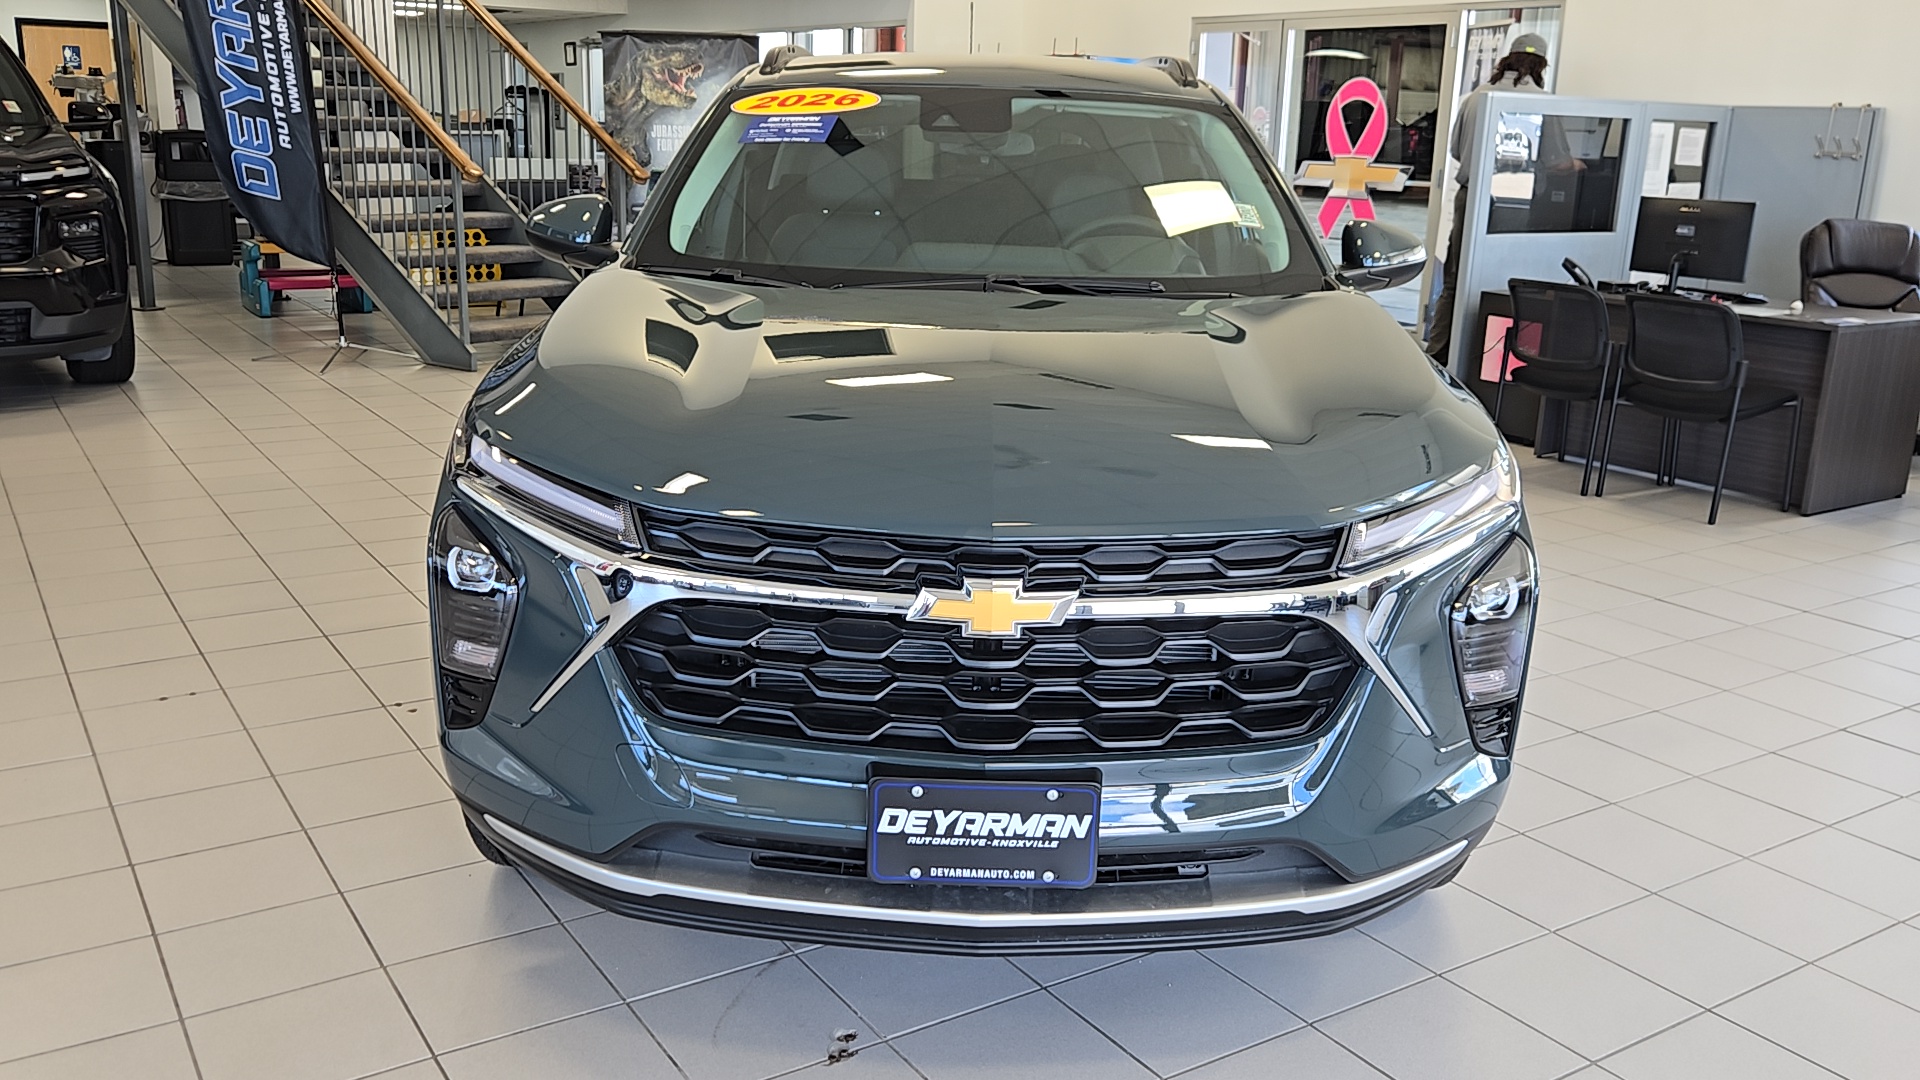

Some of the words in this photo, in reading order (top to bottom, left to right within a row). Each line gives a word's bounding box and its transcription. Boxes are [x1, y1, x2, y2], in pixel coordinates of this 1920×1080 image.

[256, 0, 292, 149] AUTOMOTIVE-
[746, 93, 865, 110] 2026
[657, 138, 673, 152] FOR
[877, 807, 1092, 839] DEYARMAN
[906, 836, 1060, 849] AUTOMOTIVE-KNOXVILLE
[930, 867, 1035, 880] DEYARMANAUTO.COM
